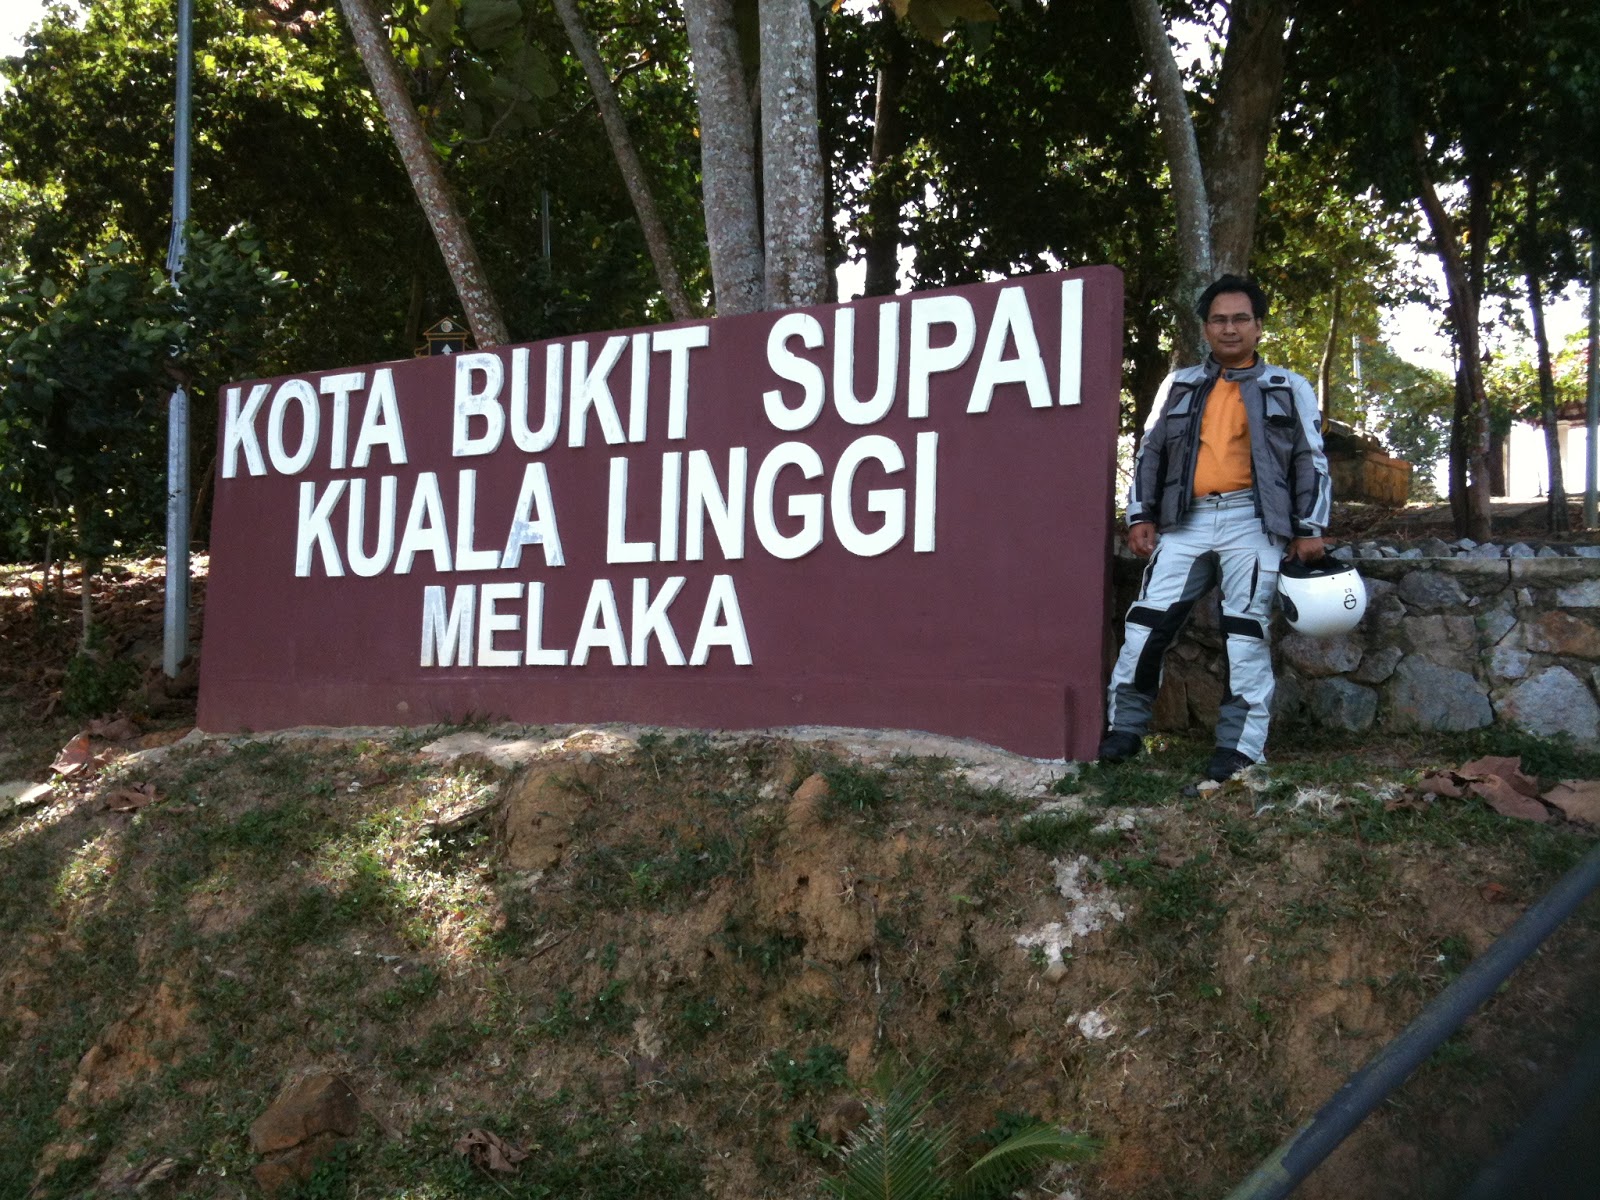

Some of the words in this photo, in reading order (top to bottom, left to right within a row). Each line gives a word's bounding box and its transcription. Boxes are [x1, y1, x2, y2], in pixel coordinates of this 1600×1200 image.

[222, 368, 408, 479] KOTA
[452, 325, 709, 457] BUKIT
[763, 279, 1083, 431] SUPAI
[294, 462, 566, 577] KUALA
[606, 431, 939, 564] LINGGI
[420, 574, 753, 668] MELAKA
